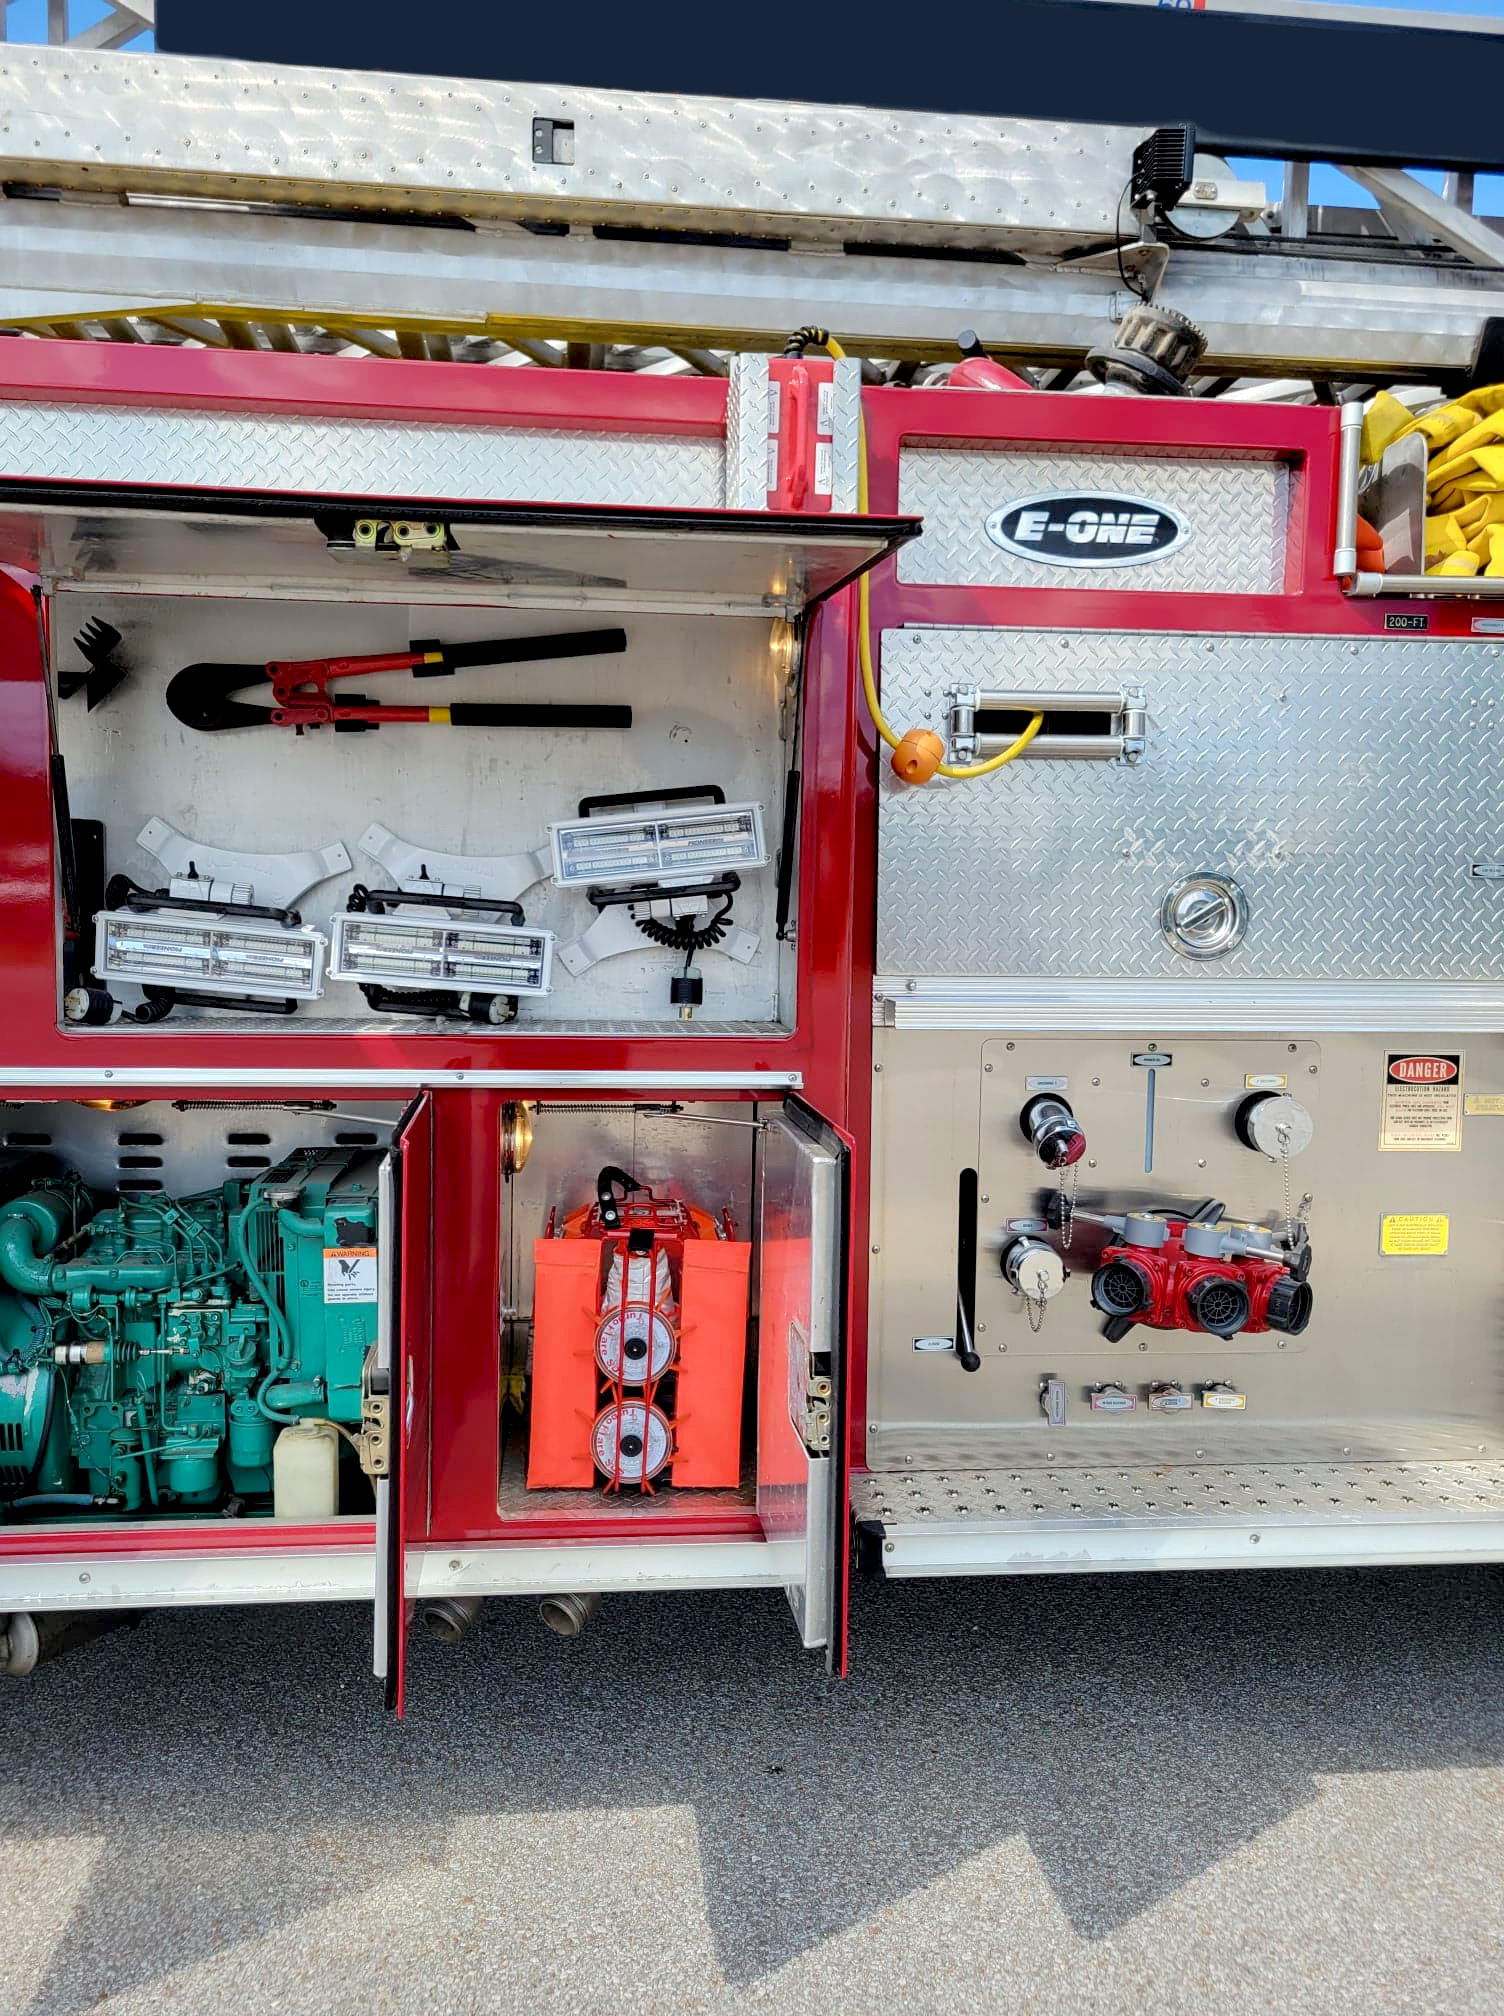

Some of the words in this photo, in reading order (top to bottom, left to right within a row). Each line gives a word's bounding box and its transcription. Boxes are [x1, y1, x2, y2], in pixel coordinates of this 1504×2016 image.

[1014, 510, 1160, 545] E-ONE
[1389, 617, 1424, 627] 200-FT
[1400, 1062, 1447, 1078] DANGER
